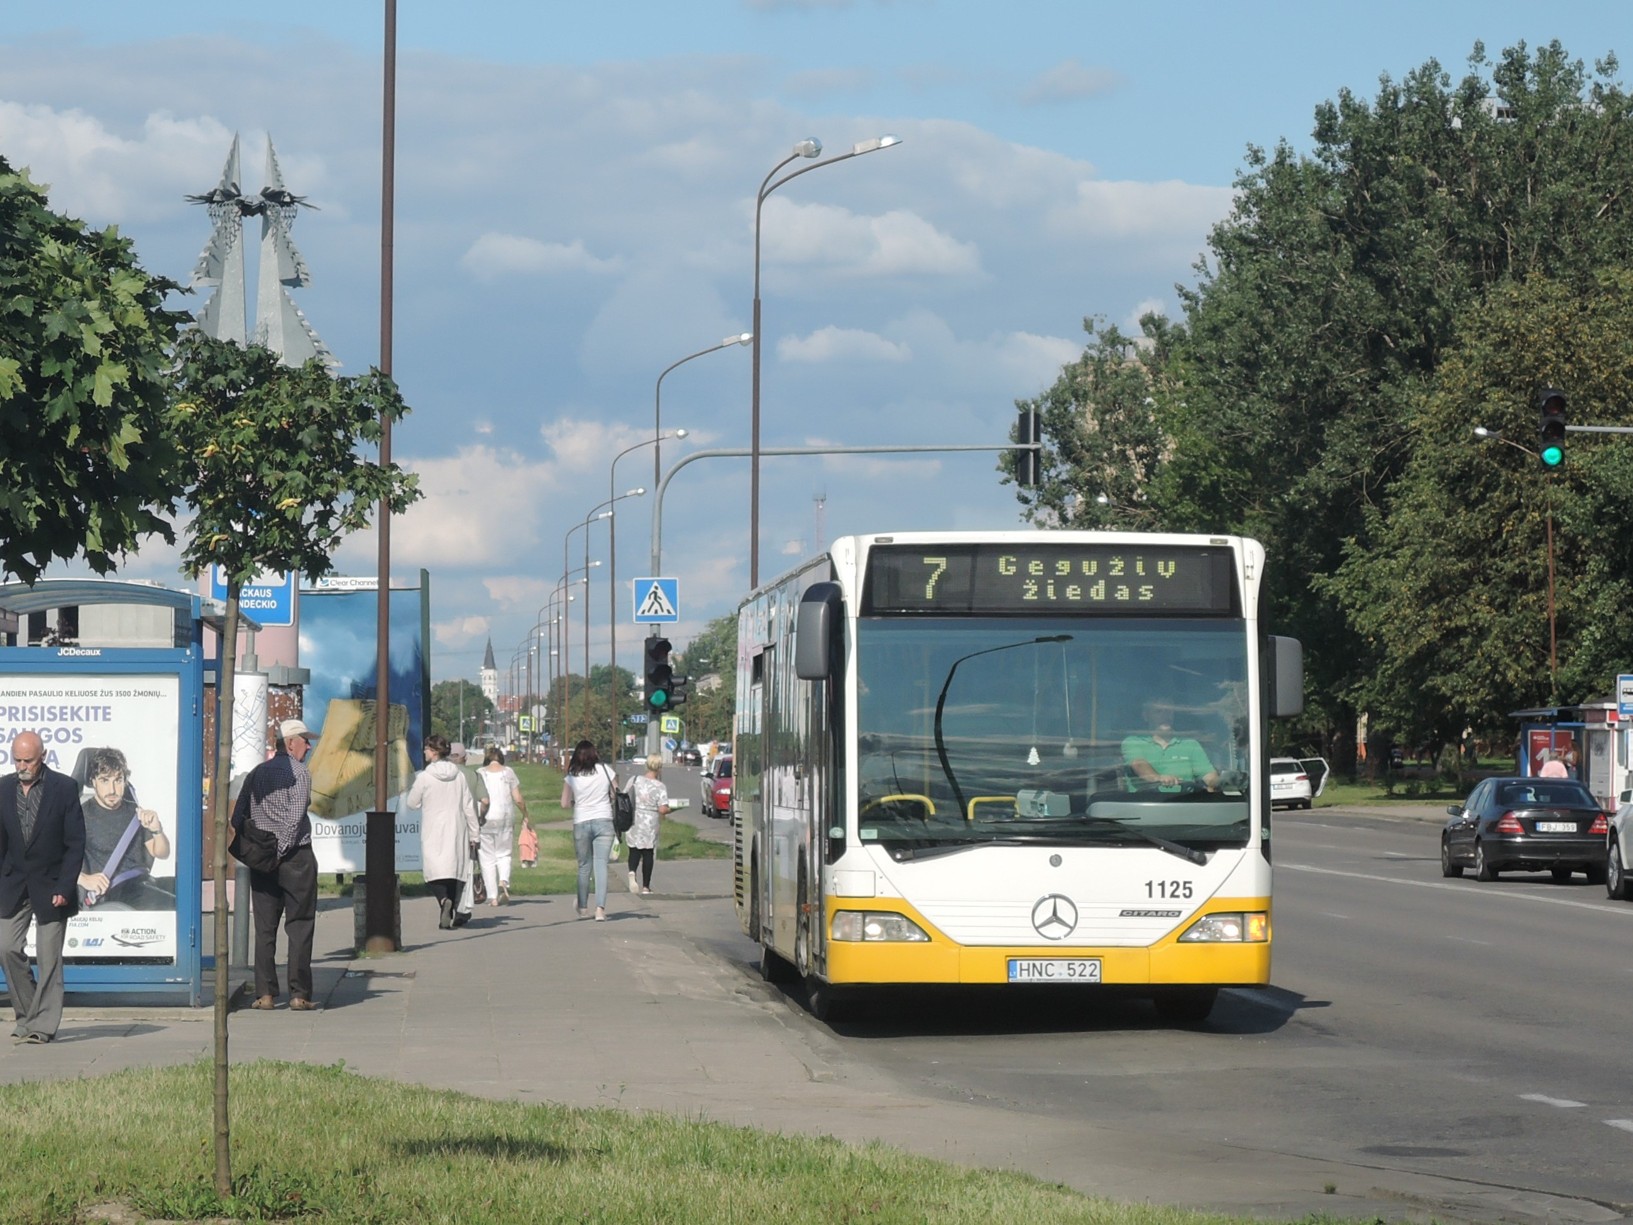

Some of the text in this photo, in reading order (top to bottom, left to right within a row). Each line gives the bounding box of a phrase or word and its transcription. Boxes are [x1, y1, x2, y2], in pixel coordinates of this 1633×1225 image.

[329, 579, 348, 587] Clear
[923, 556, 947, 599] 7
[239, 588, 272, 598] CKAUS
[1023, 579, 1154, 600] žiedas
[239, 599, 277, 609] NDECKIO
[57, 647, 101, 657] JCDecaux
[0, 690, 27, 698] ANDIEN
[29, 690, 63, 698] PASAULIO
[65, 690, 98, 698] KELIUOSE
[100, 688, 114, 698] ŽUS
[115, 690, 132, 698] 3500
[0, 705, 112, 722] PRISISEKITE
[395, 821, 420, 835] uvai
[1145, 880, 1194, 899] 1125
[1019, 962, 1098, 978] HNC 522
